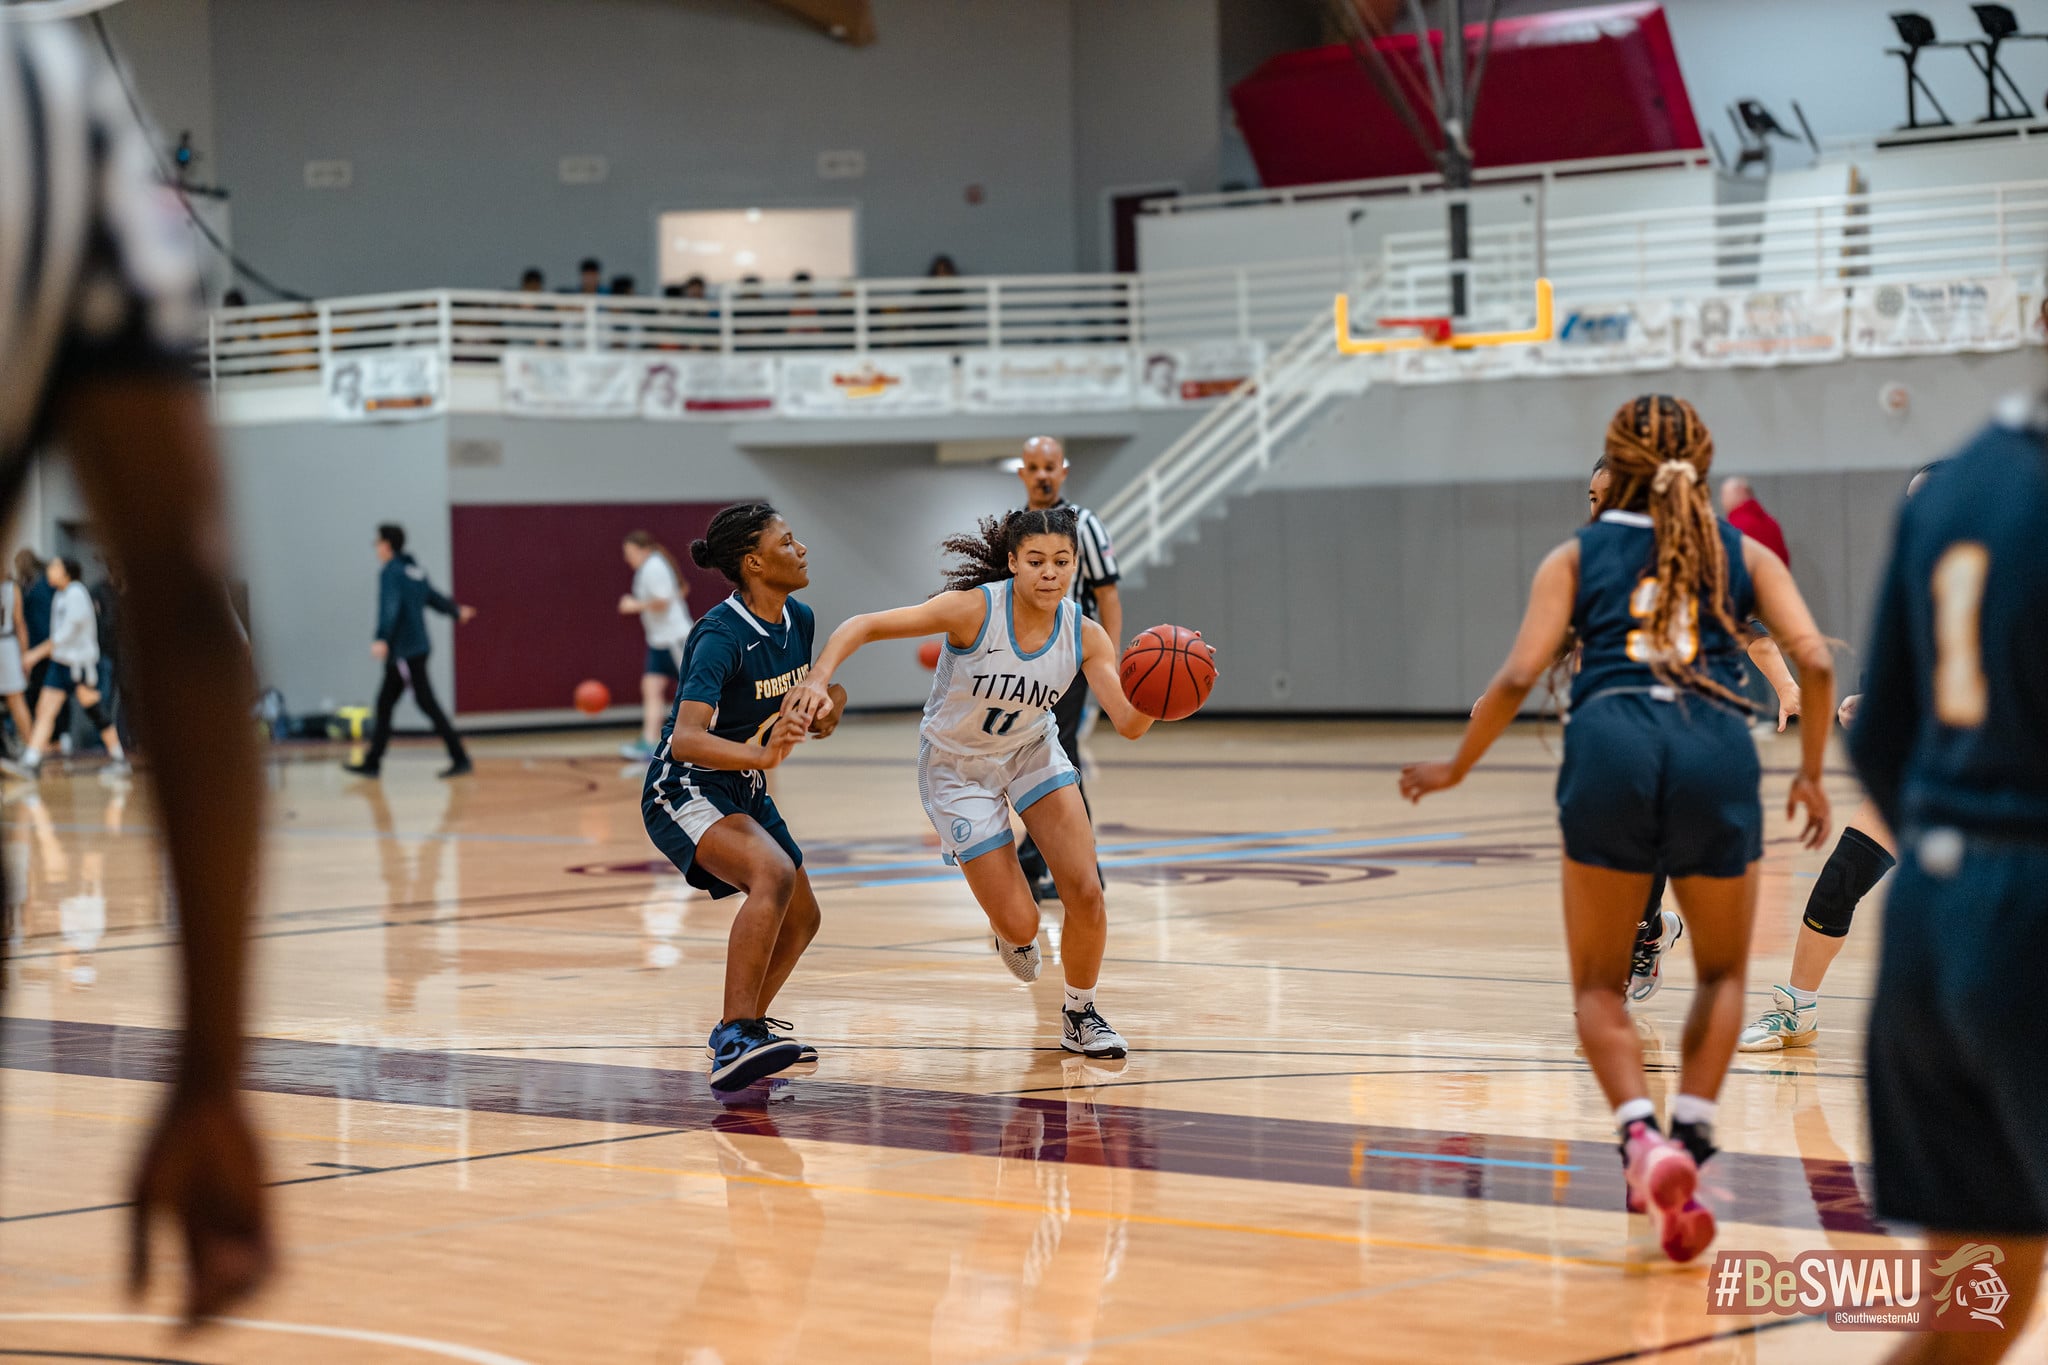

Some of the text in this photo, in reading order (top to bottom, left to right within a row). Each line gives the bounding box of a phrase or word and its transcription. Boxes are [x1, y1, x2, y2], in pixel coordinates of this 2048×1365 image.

[1930, 541, 1990, 728] 1
[755, 673, 793, 700] FOREST
[972, 674, 1060, 711] TITANS
[982, 707, 1023, 736] 11
